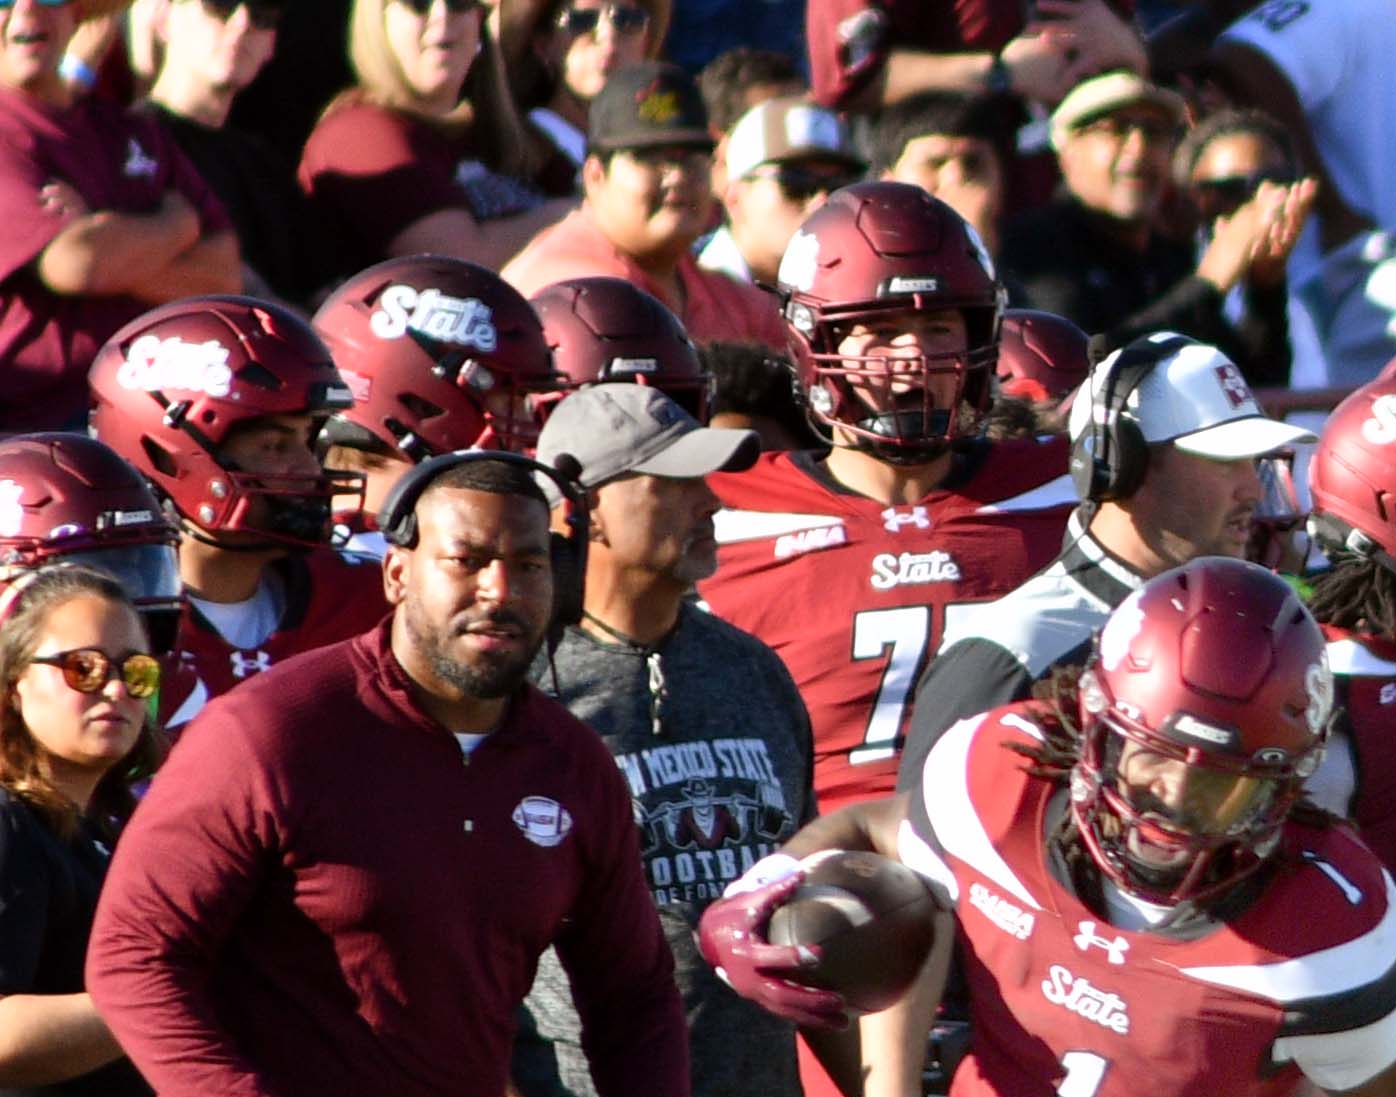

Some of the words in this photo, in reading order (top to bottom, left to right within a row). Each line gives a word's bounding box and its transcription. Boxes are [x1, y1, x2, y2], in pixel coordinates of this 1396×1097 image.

[371, 284, 497, 352] State
[870, 550, 961, 590] State
[641, 740, 718, 789] MEXICO
[712, 738, 782, 787] STATE
[1041, 964, 1131, 1035] State
